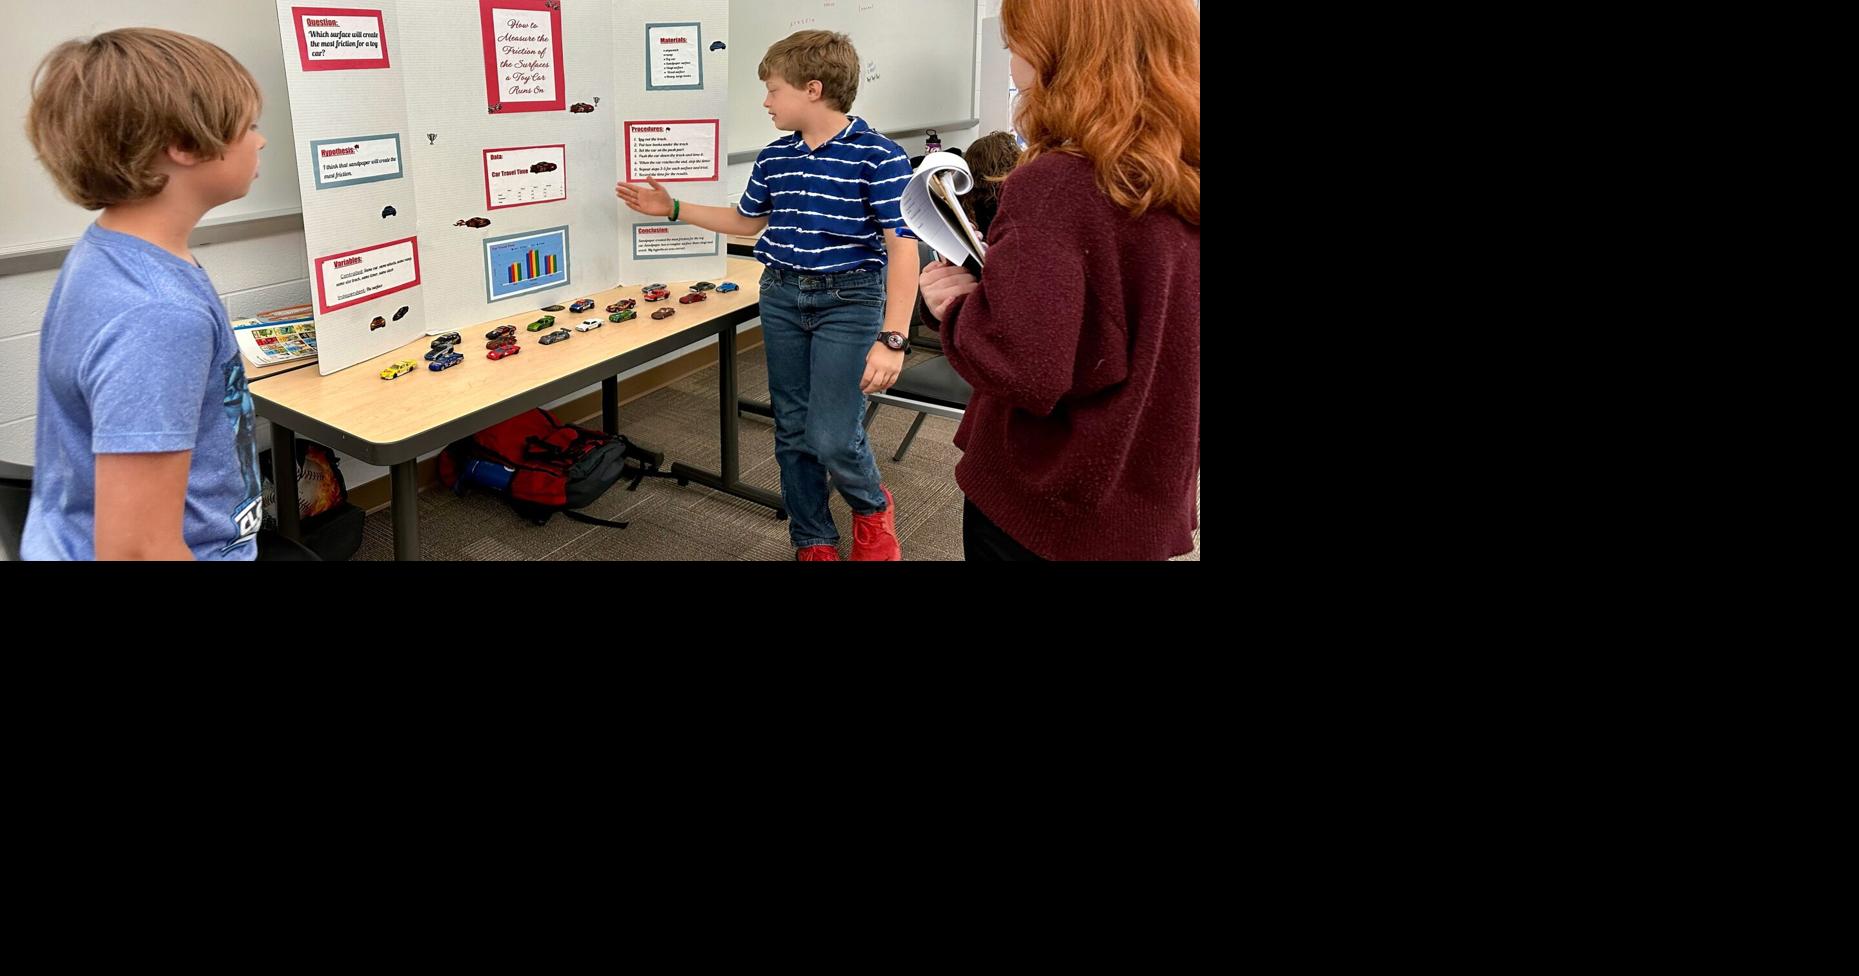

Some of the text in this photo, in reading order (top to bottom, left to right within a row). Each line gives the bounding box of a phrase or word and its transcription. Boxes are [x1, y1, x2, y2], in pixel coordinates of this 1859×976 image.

[307, 18, 340, 27] Question:
[507, 19, 529, 29] How
[498, 33, 536, 42] Measure
[335, 40, 356, 48] friction
[502, 46, 546, 58] Friction of
[514, 60, 549, 71] Surfaces
[512, 72, 531, 84] Toy
[532, 73, 546, 81] Car
[509, 86, 532, 94] Runs
[321, 147, 355, 158] Hypothesis:
[334, 256, 362, 269] Variables:
